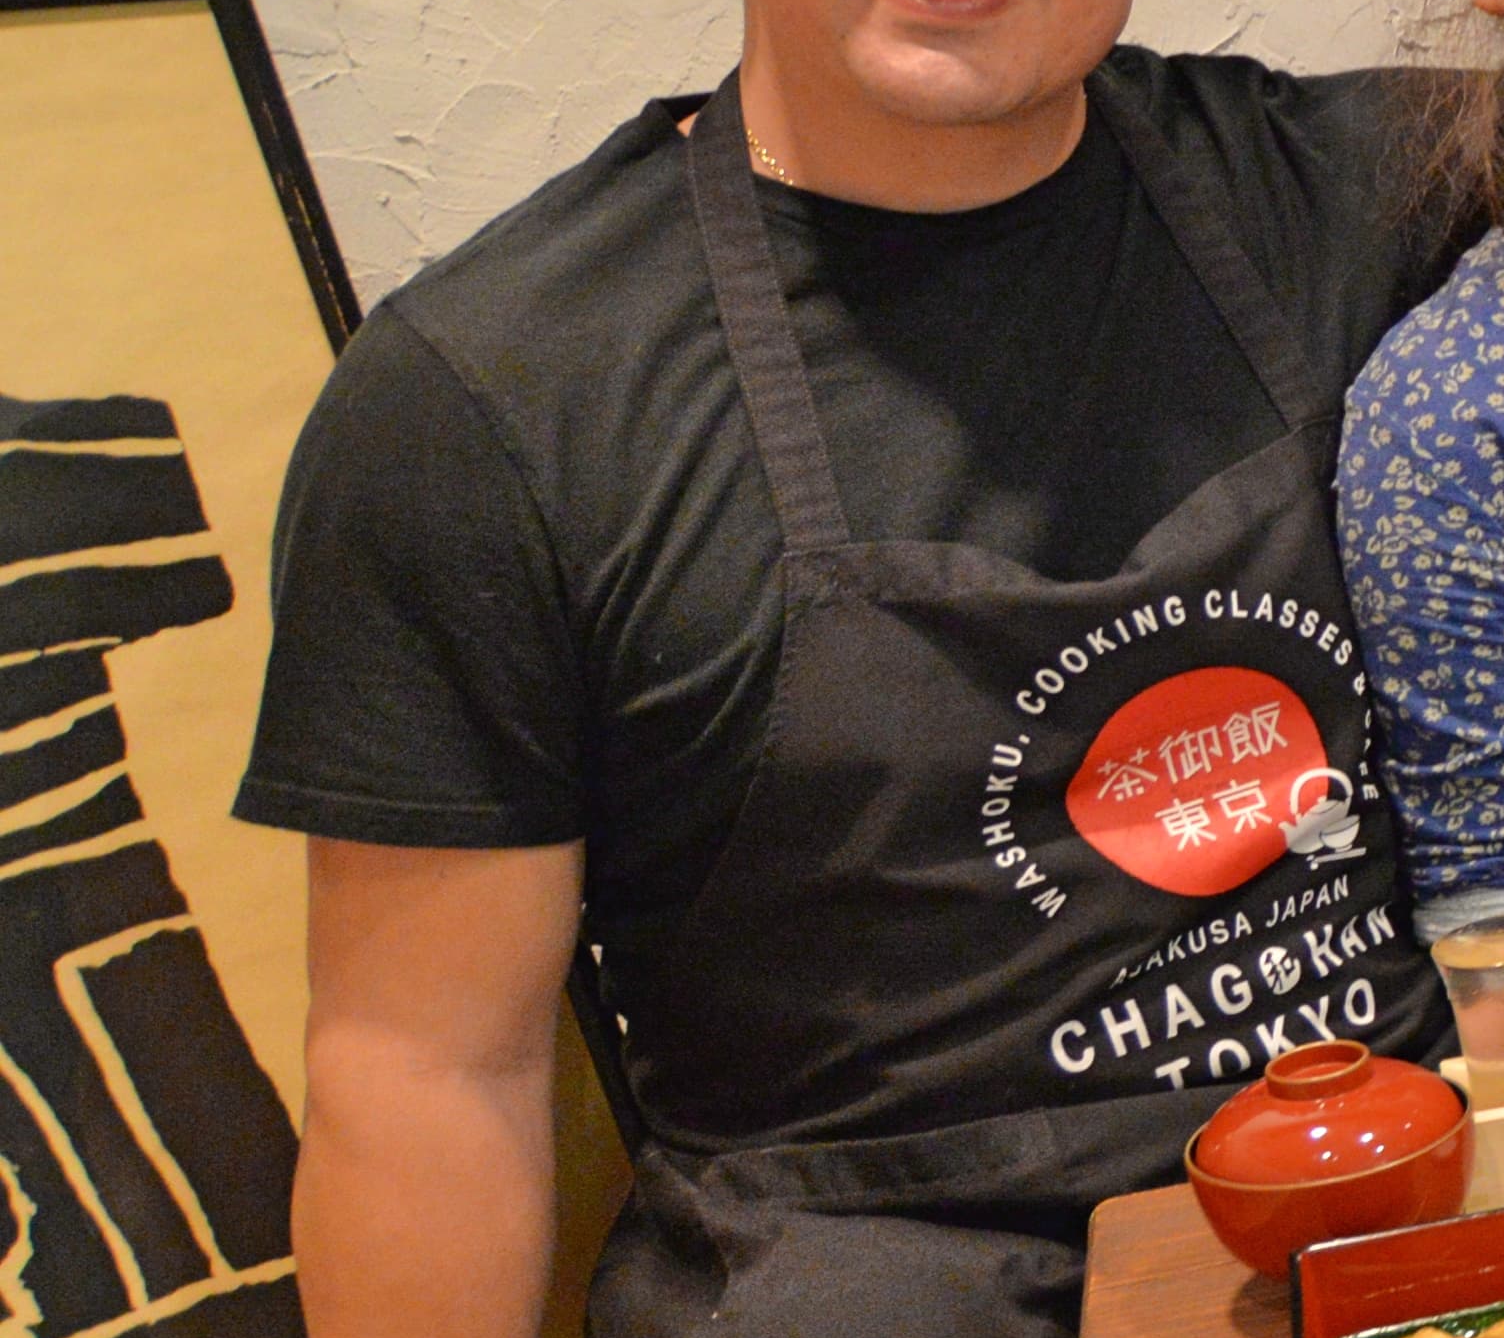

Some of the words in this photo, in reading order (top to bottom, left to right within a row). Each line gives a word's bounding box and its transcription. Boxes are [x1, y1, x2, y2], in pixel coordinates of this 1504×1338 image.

[1016, 594, 1188, 715] COOKING
[1204, 588, 1353, 666] CLASSES
[1096, 701, 1288, 802] 茶御飯
[982, 731, 1069, 920] WASHOKU,
[1154, 779, 1273, 852] 東京
[1265, 874, 1349, 928] JAPAN
[1154, 977, 1377, 1092] TOKYO
